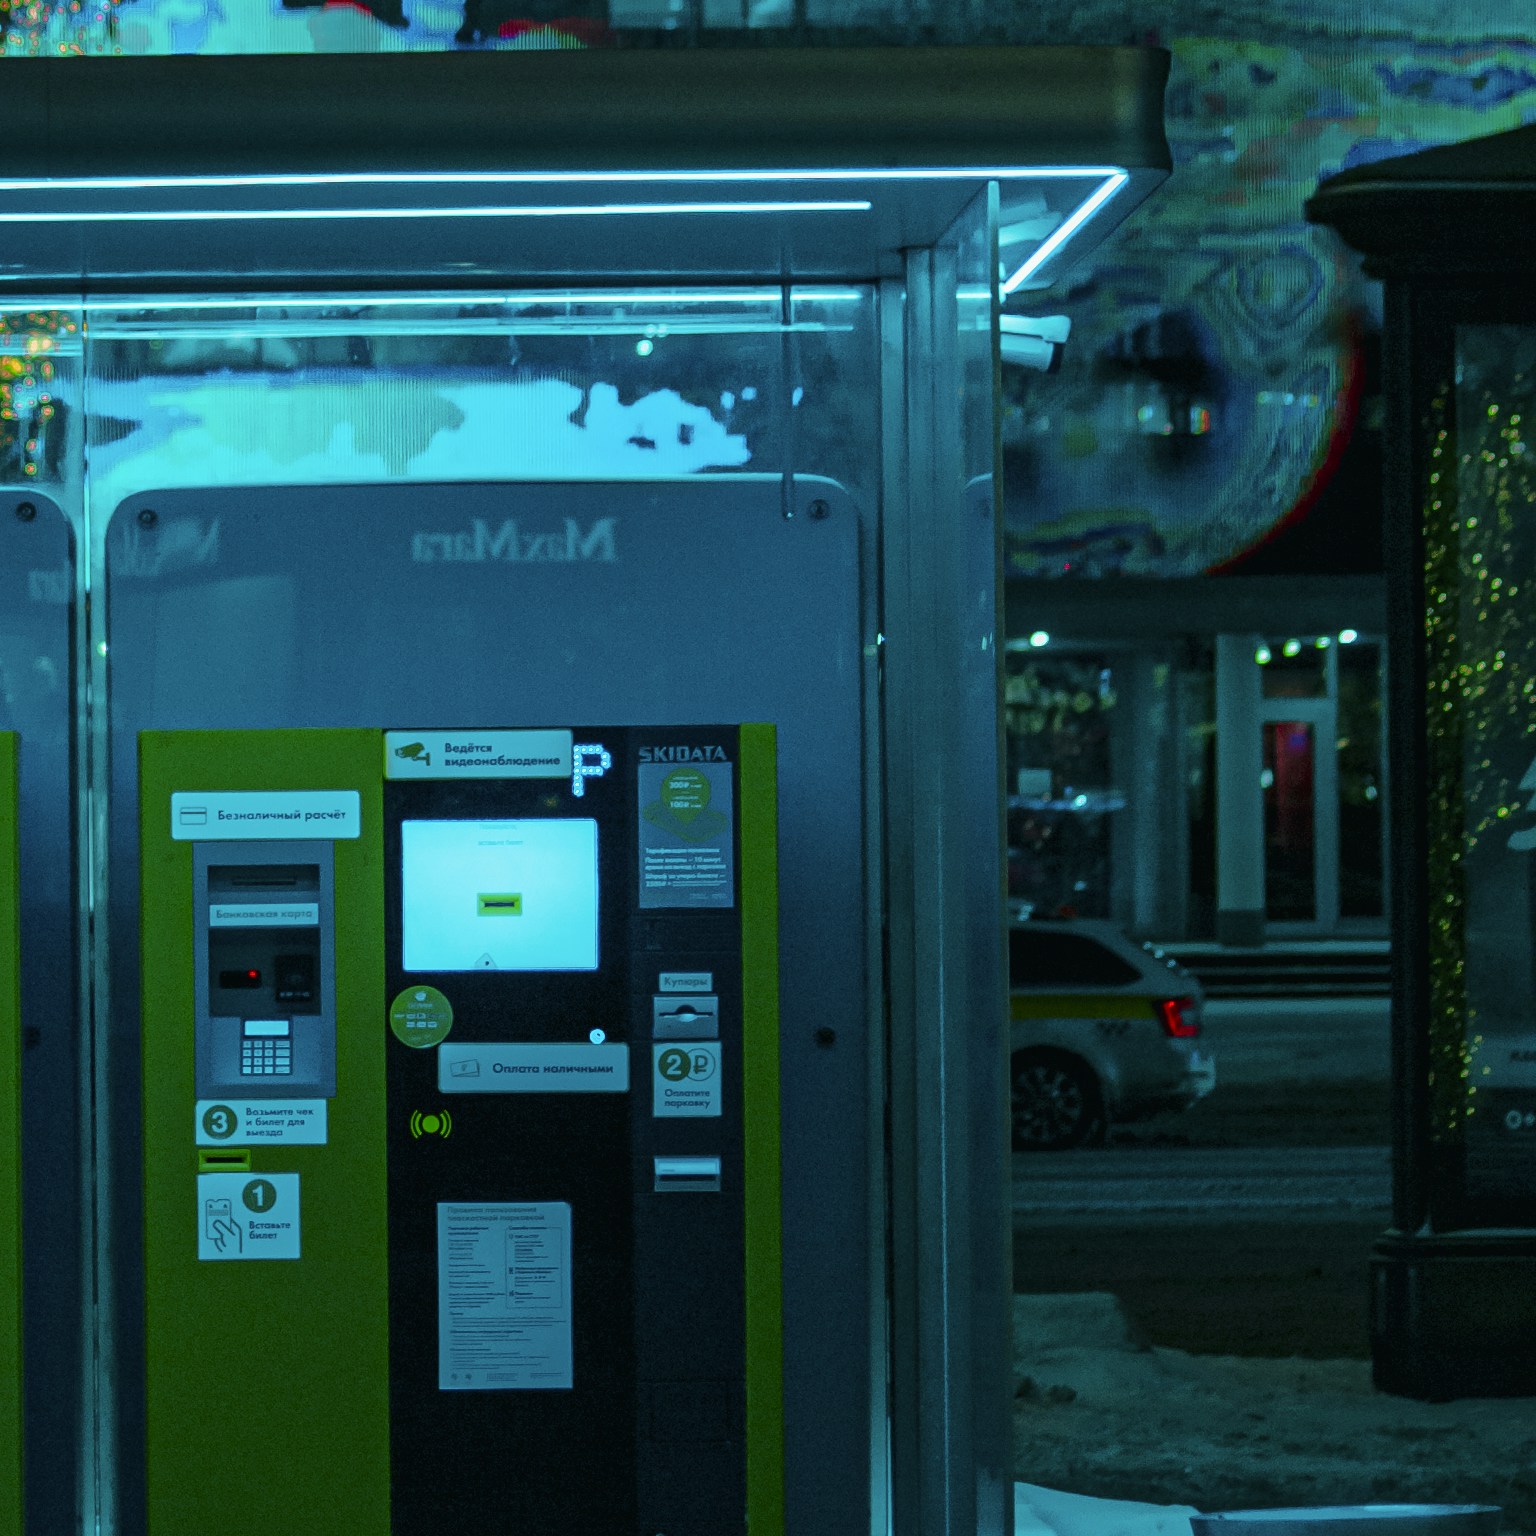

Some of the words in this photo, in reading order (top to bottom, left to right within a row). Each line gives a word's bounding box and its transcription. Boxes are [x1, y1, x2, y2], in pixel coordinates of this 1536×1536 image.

[444, 742, 492, 754] Ведётся
[638, 745, 727, 762] SKIDATA
[444, 755, 560, 767] видеонаблюдение
[218, 809, 301, 821] Безналичный
[305, 810, 346, 822] расчёт
[216, 910, 277, 919] Банковская
[280, 910, 312, 920] карта
[664, 976, 708, 987] Купюры
[492, 1062, 540, 1074] Оплата
[543, 1064, 614, 1074] наличными
[666, 1054, 682, 1076] 2
[664, 1089, 710, 1098] Оплатите
[664, 1099, 711, 1109] парковку
[246, 1107, 293, 1116] Возьмите
[296, 1108, 314, 1116] чек
[210, 1111, 229, 1134] 3
[255, 1117, 285, 1126] билет
[287, 1119, 305, 1127] для
[252, 1184, 265, 1207] 1
[249, 1221, 291, 1229] Вставьте
[249, 1231, 277, 1239] билет
